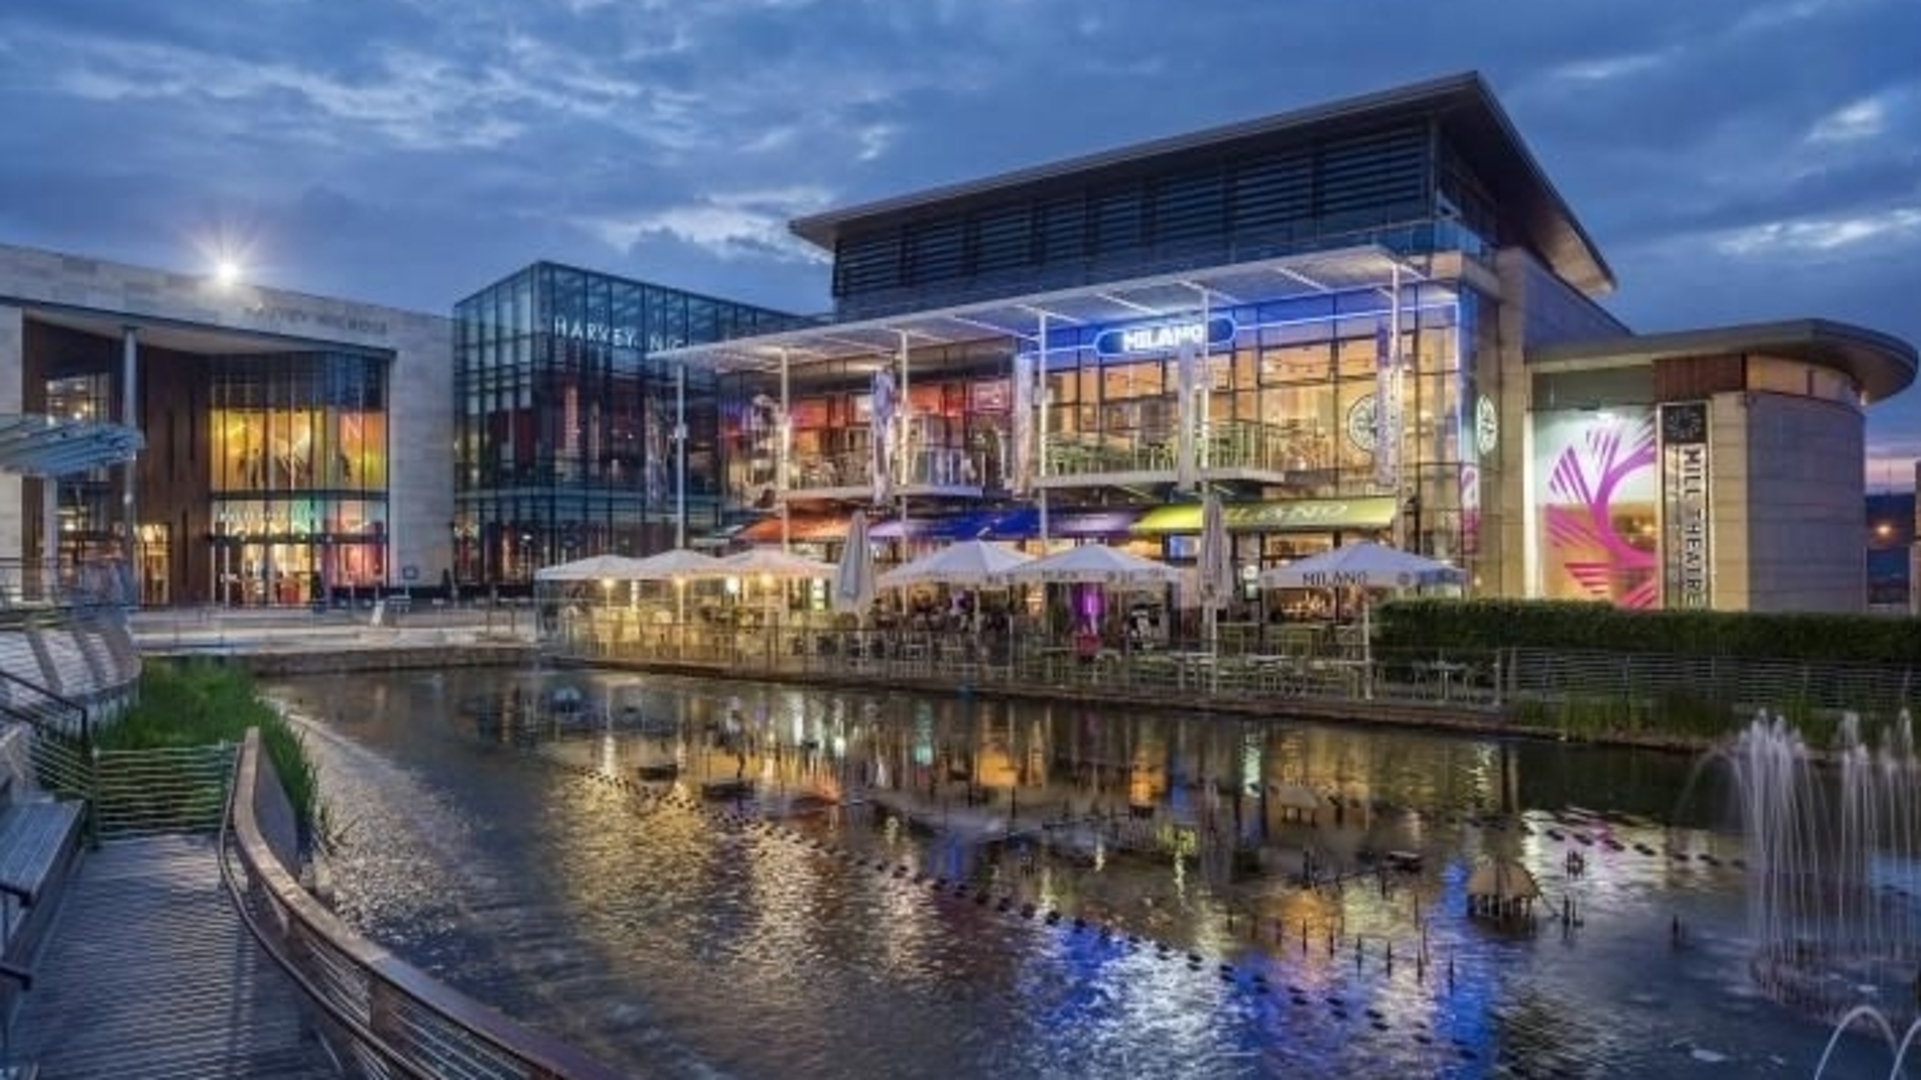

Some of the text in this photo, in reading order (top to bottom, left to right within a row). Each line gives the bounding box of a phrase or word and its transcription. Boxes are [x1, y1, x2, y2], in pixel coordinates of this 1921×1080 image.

[554, 315, 638, 348] HARVEY
[1123, 324, 1203, 352] MILANO
[1683, 449, 1703, 605] MILL THEATRE
[1302, 569, 1368, 586] MILANO
